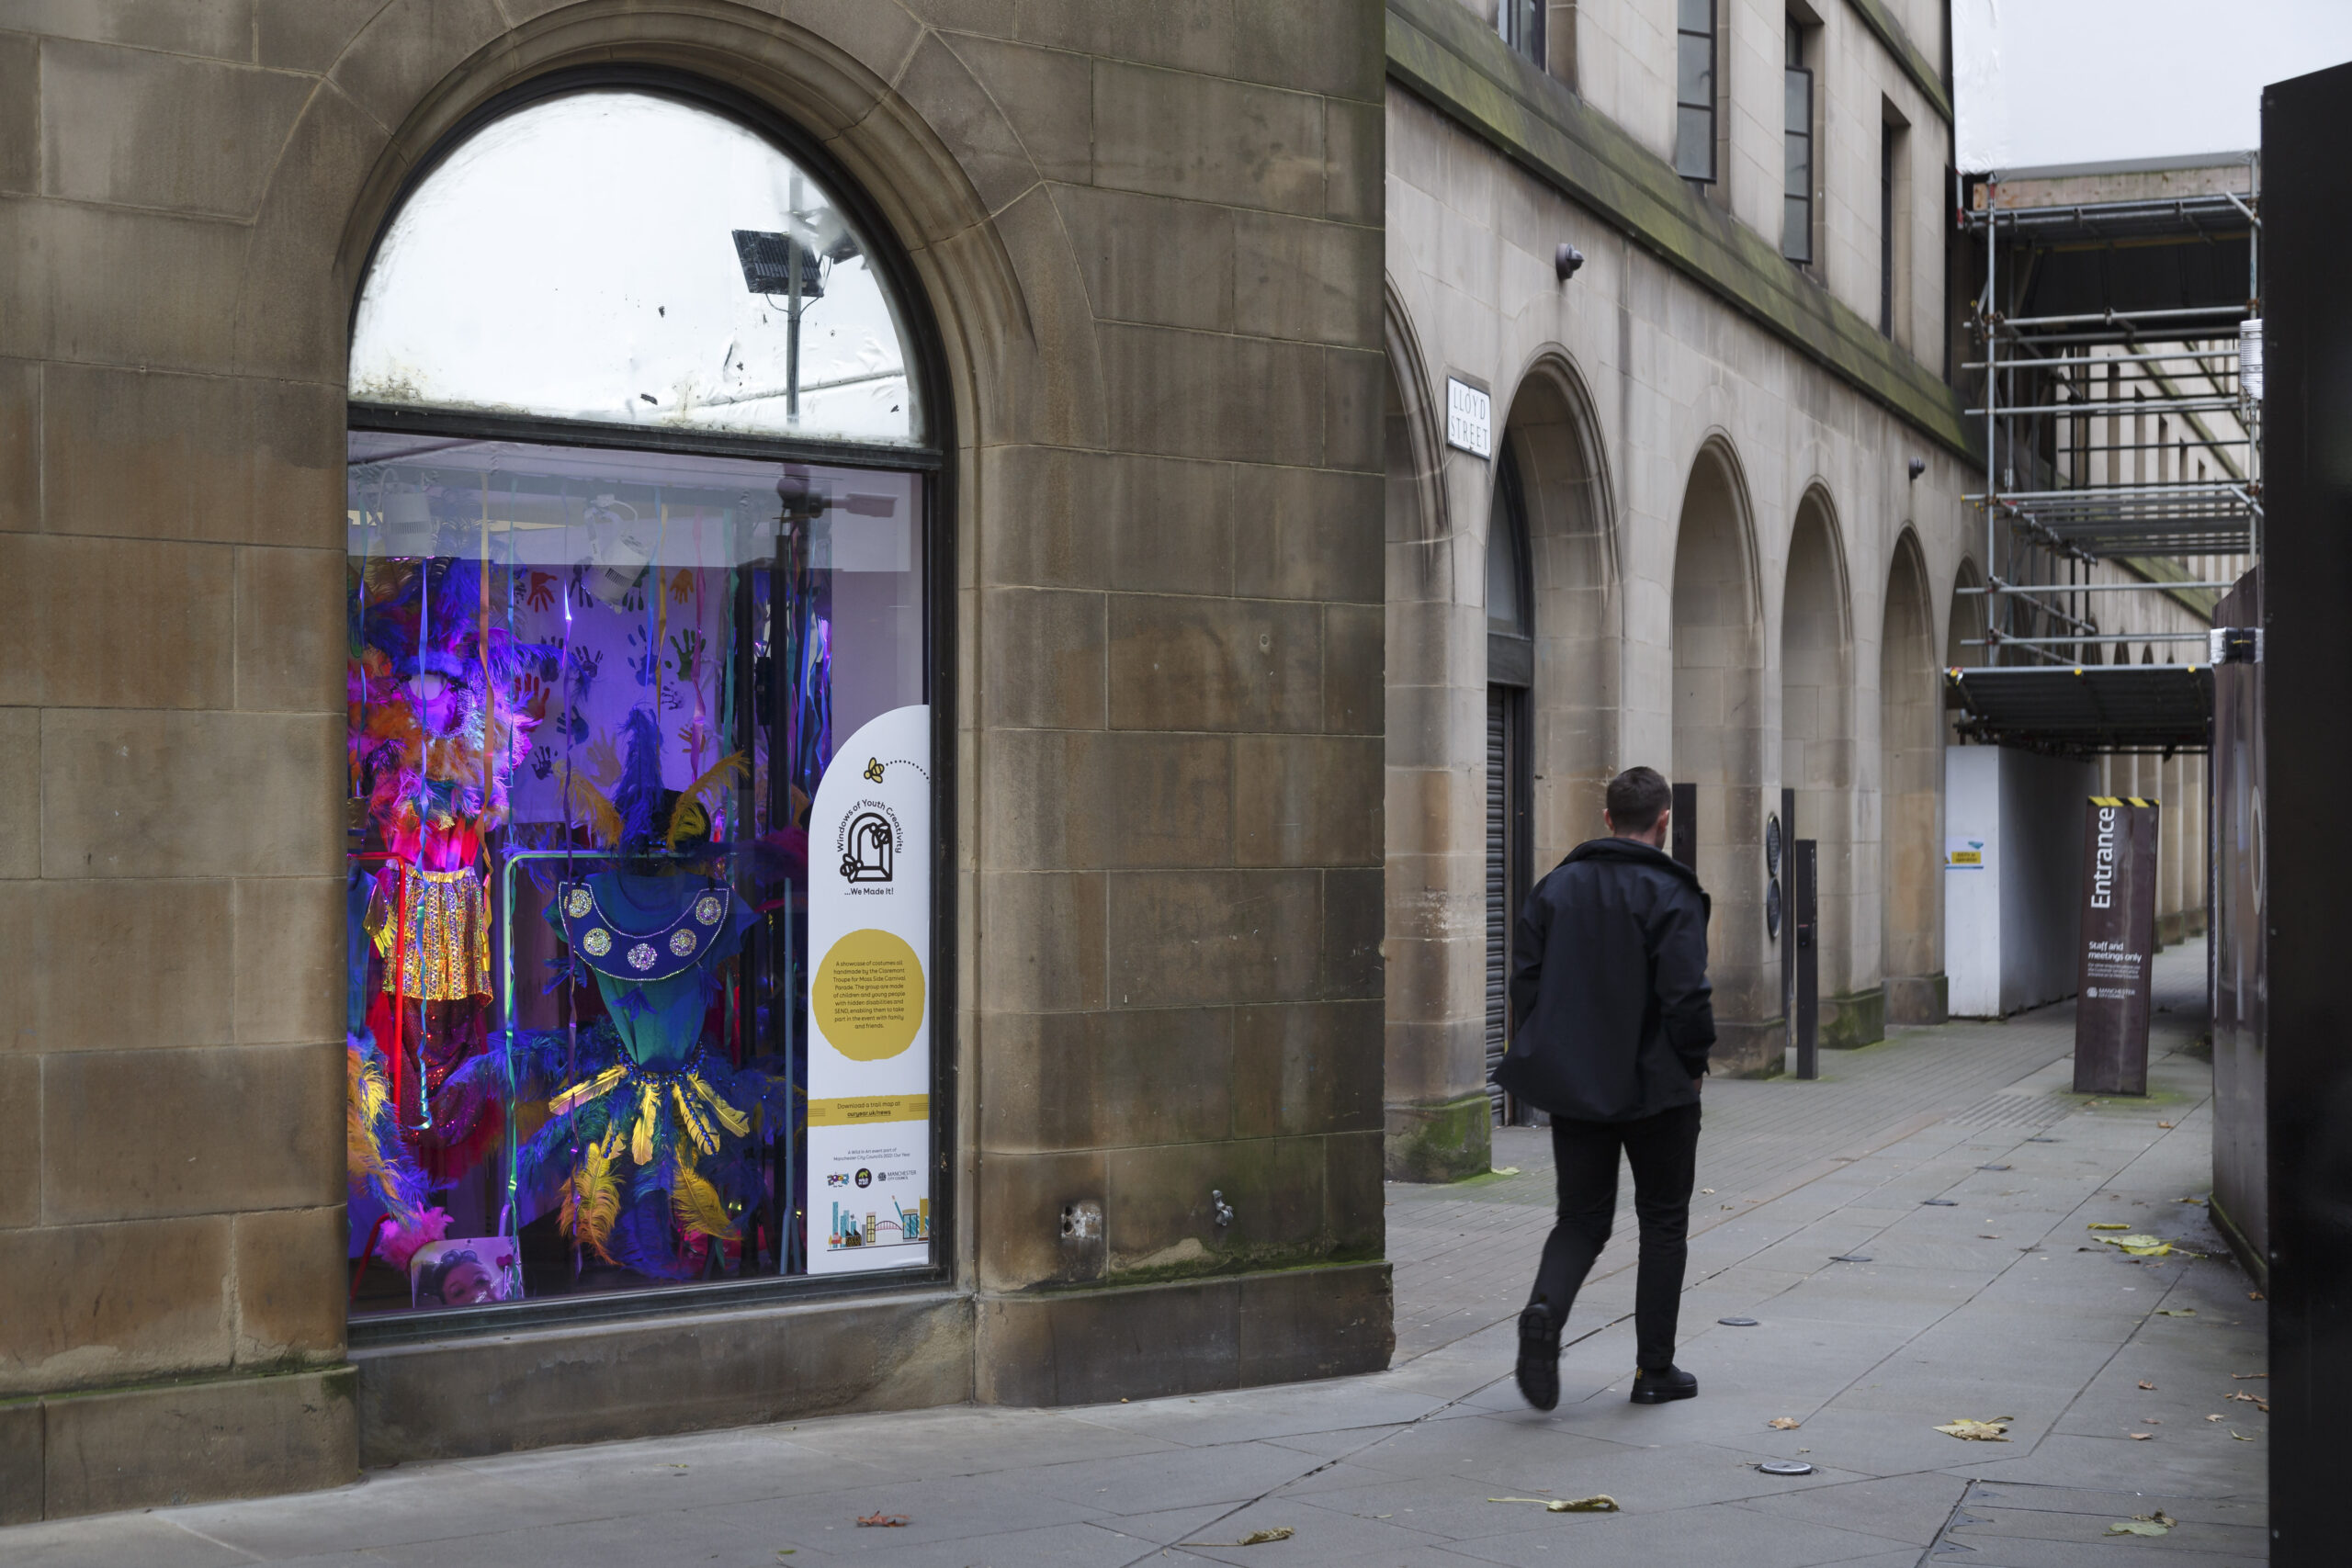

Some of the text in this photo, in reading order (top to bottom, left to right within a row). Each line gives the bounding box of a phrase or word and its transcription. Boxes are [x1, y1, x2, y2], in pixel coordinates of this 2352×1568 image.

[1453, 387, 1486, 420] LLOYD
[1451, 416, 1488, 450] STREET
[837, 798, 904, 853] Windows of Youth Creativity
[2090, 807, 2115, 909] Entrance
[864, 887, 884, 896] Made
[886, 887, 894, 896] It!
[2088, 941, 2124, 952] Staff and
[2088, 952, 2143, 964] meetings only
